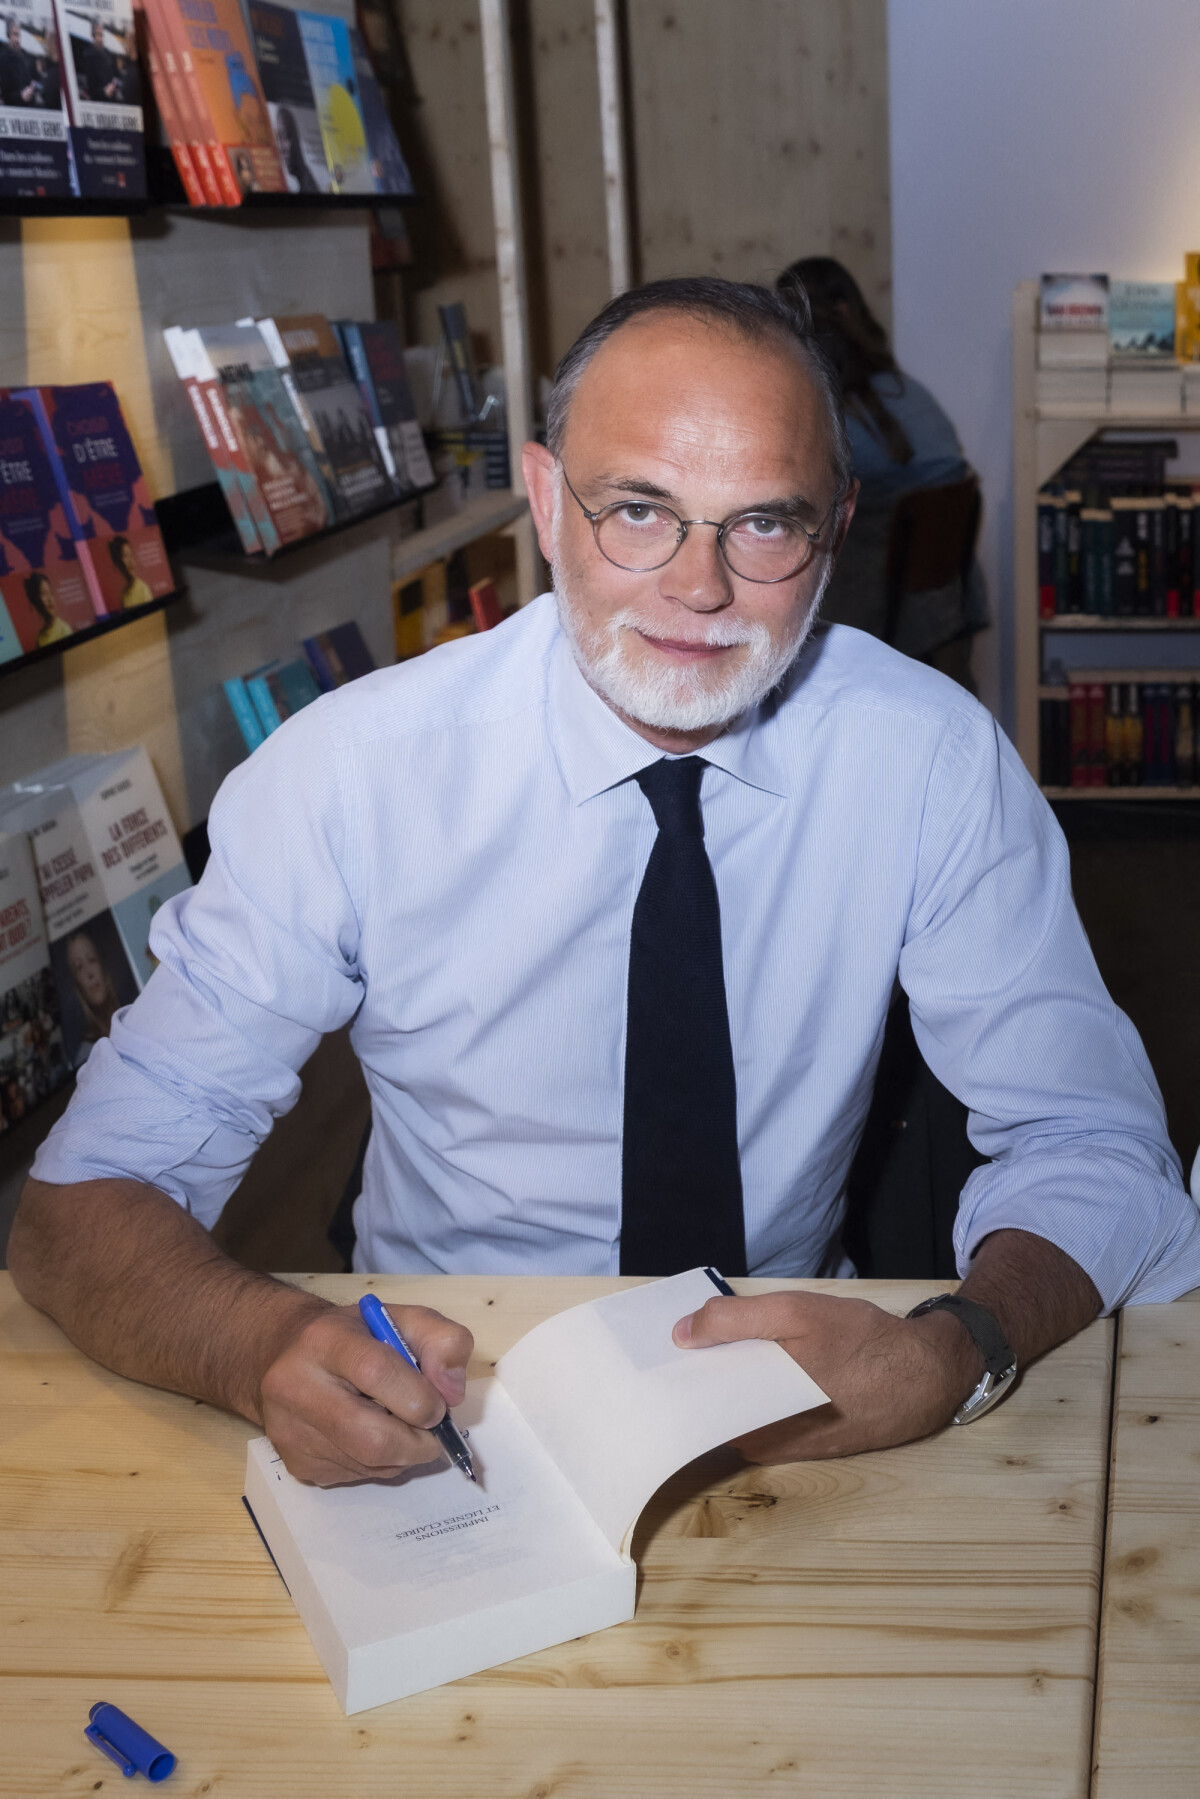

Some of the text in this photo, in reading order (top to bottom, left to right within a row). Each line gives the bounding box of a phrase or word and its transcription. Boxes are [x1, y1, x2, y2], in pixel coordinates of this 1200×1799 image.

[72, 437, 119, 463] D'ÊTRE
[108, 822, 123, 842] LA
[101, 845, 122, 869] DES
[395, 1504, 500, 1540] ET LIGNES CLAIRES
[415, 1516, 489, 1542] IMPRESSIONS
